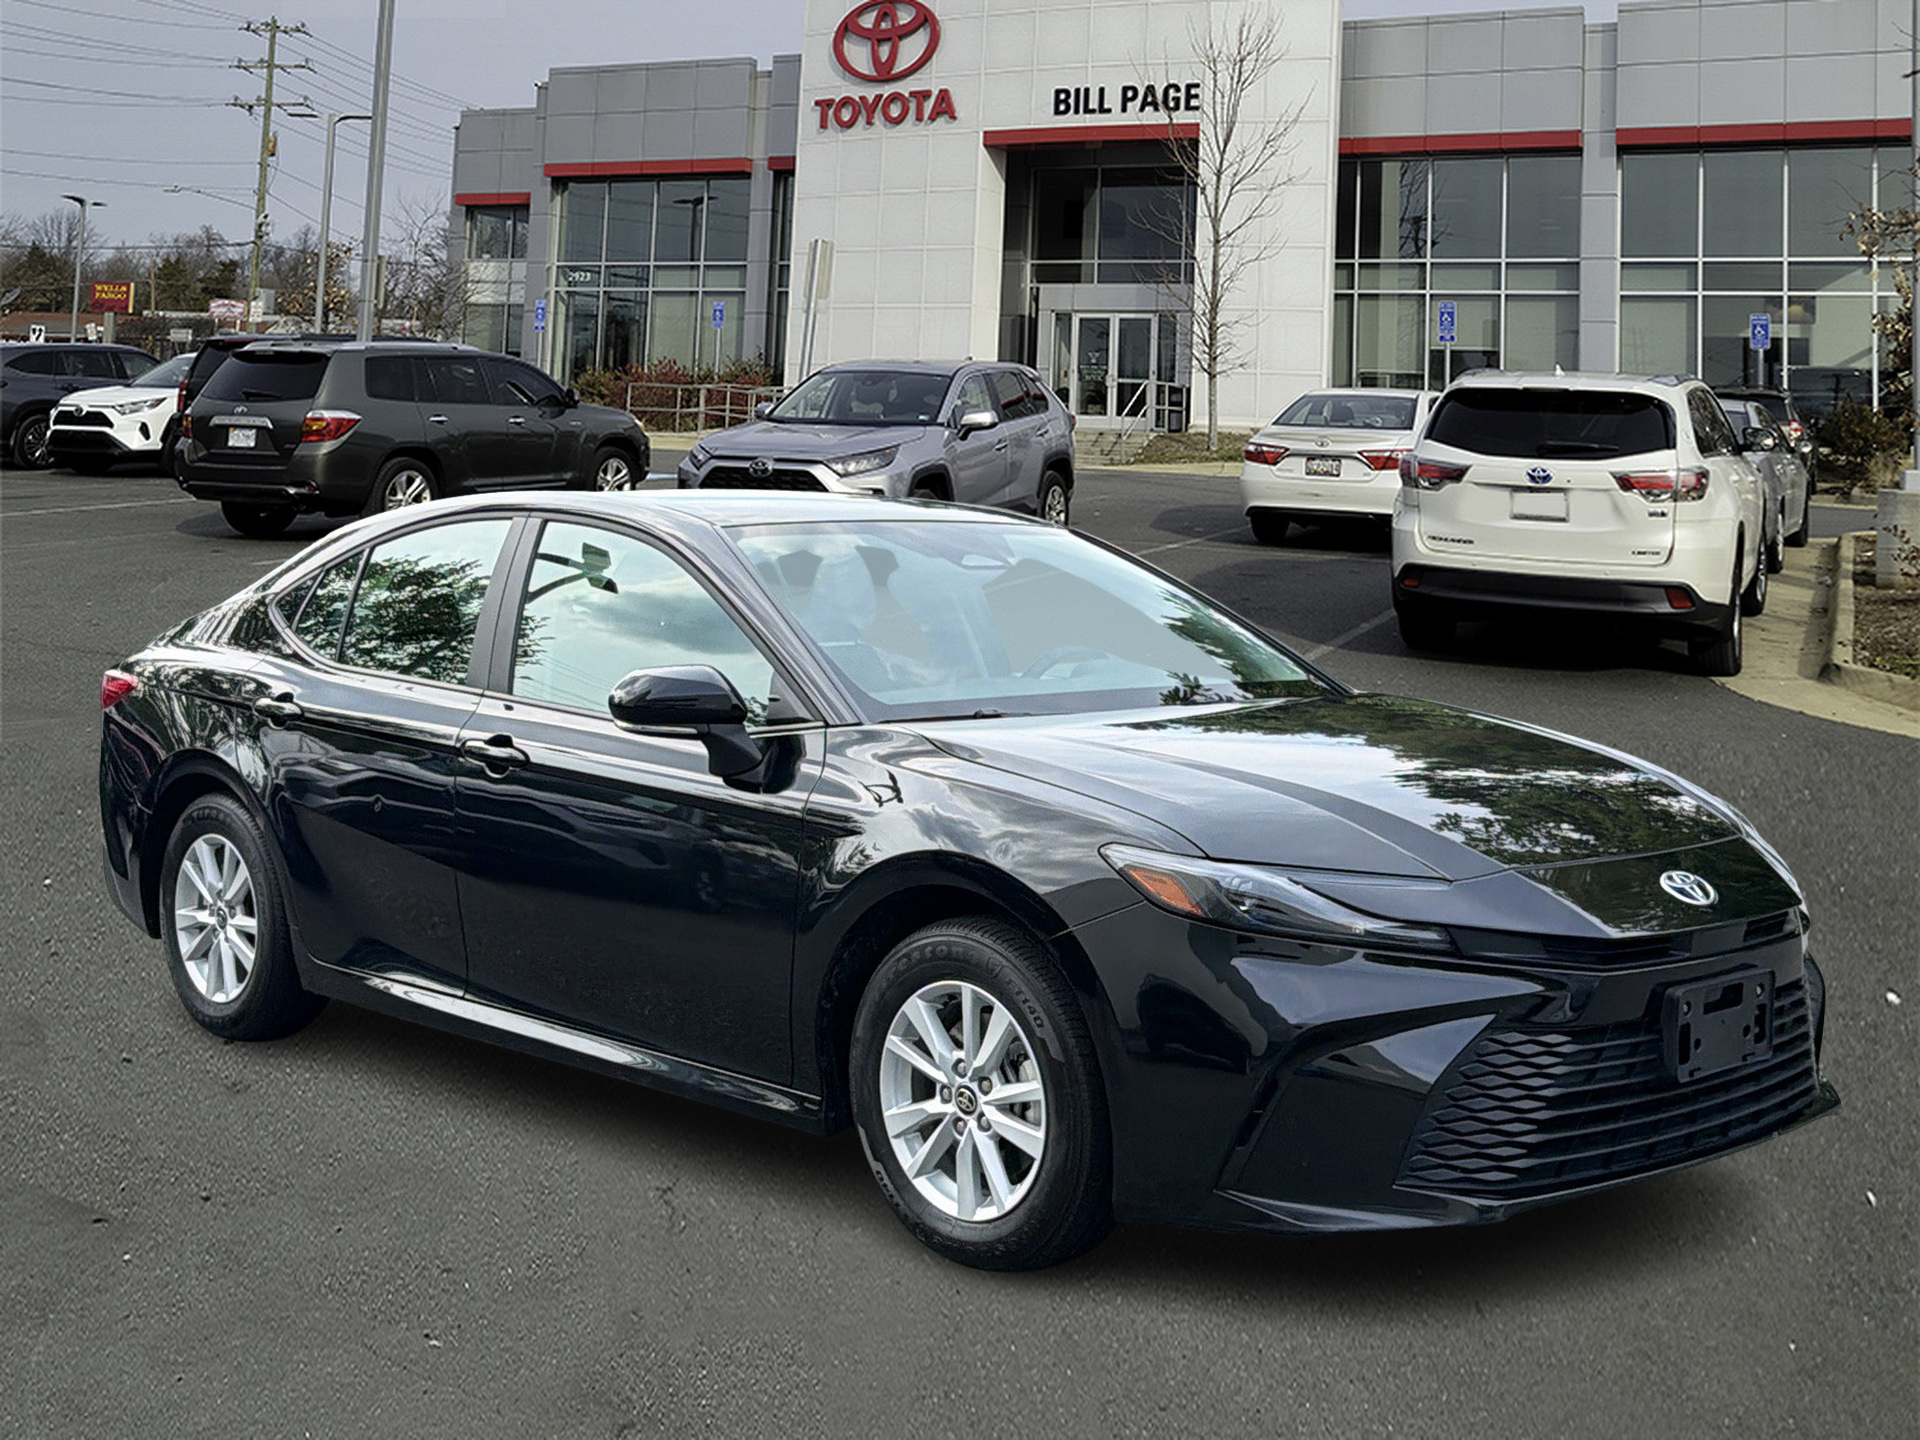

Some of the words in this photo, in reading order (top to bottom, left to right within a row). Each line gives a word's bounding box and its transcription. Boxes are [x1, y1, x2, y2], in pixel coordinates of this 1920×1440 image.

[814, 88, 957, 129] TOYOTA
[1053, 87, 1113, 116] BILL
[1121, 83, 1200, 113] PAGE
[95, 291, 127, 299] FARGO
